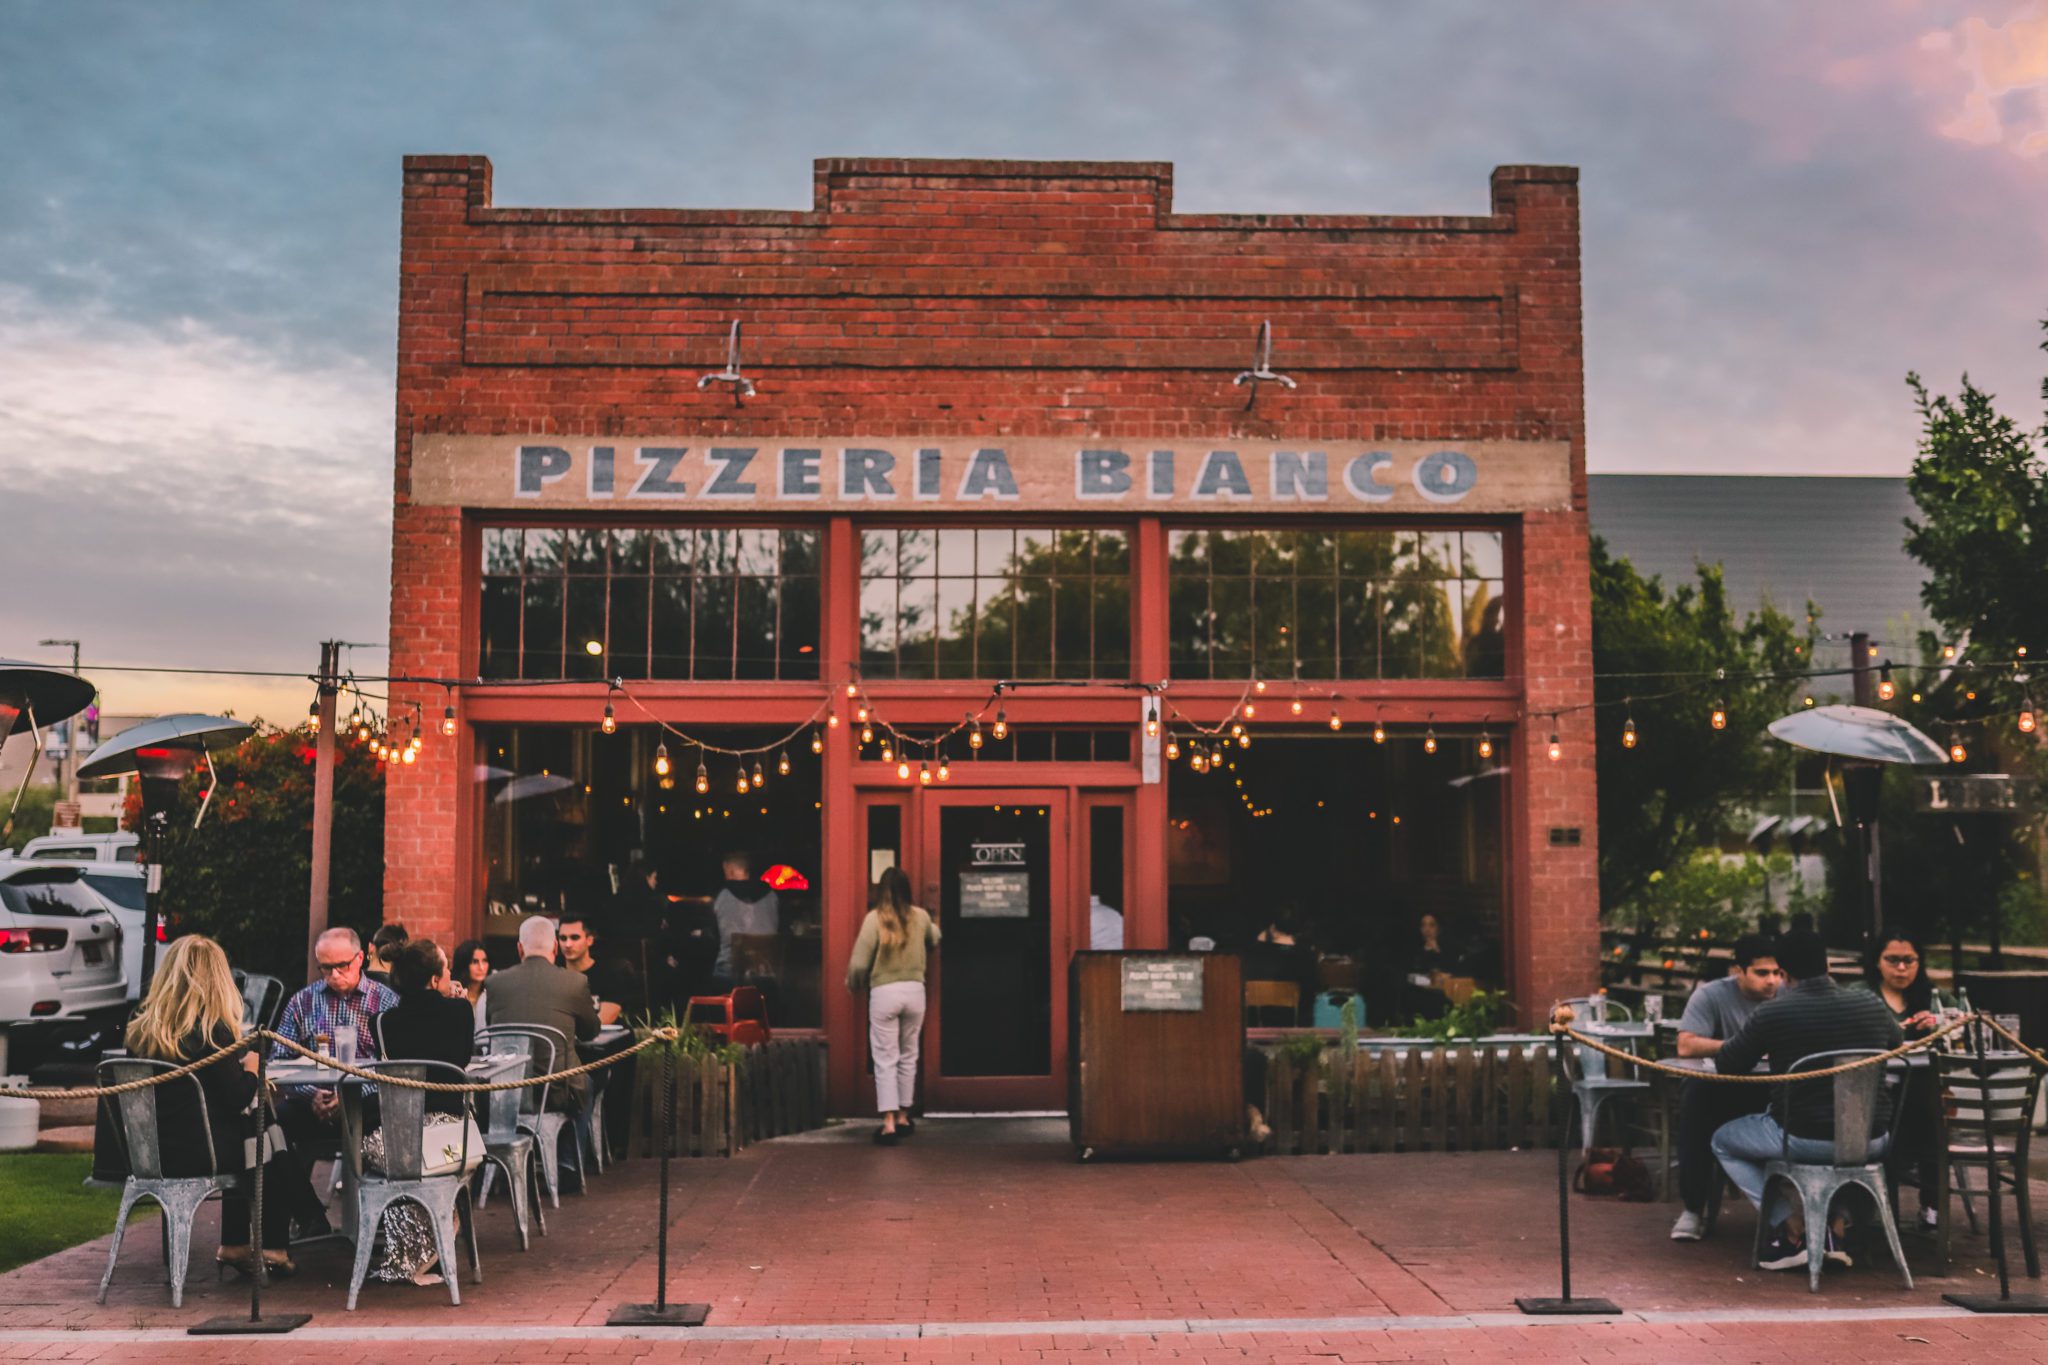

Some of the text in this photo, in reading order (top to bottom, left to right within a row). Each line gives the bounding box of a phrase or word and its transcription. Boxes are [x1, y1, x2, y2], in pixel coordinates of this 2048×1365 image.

[514, 446, 1479, 504] PIZZERIA BIANCO
[975, 847, 1023, 862] OPEN
